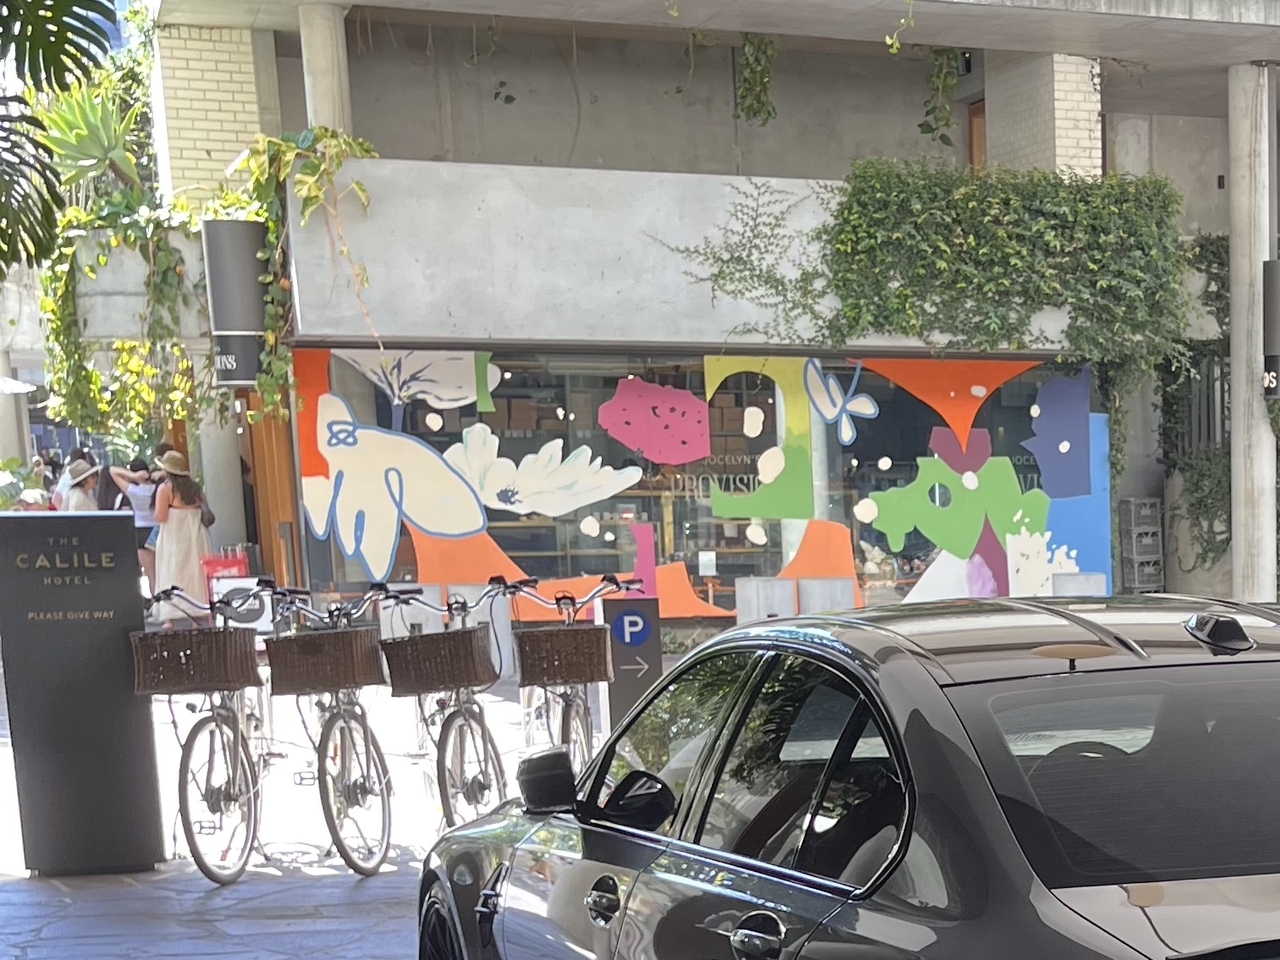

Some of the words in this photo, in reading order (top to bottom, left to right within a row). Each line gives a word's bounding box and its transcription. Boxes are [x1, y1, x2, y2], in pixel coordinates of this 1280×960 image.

[47, 537, 80, 547] THE
[16, 551, 116, 569] CALILE
[43, 576, 92, 586] HOTEL
[28, 611, 64, 621] PLEASE
[66, 610, 91, 620] GIVE
[92, 609, 115, 619] WAY
[622, 614, 644, 643] P
